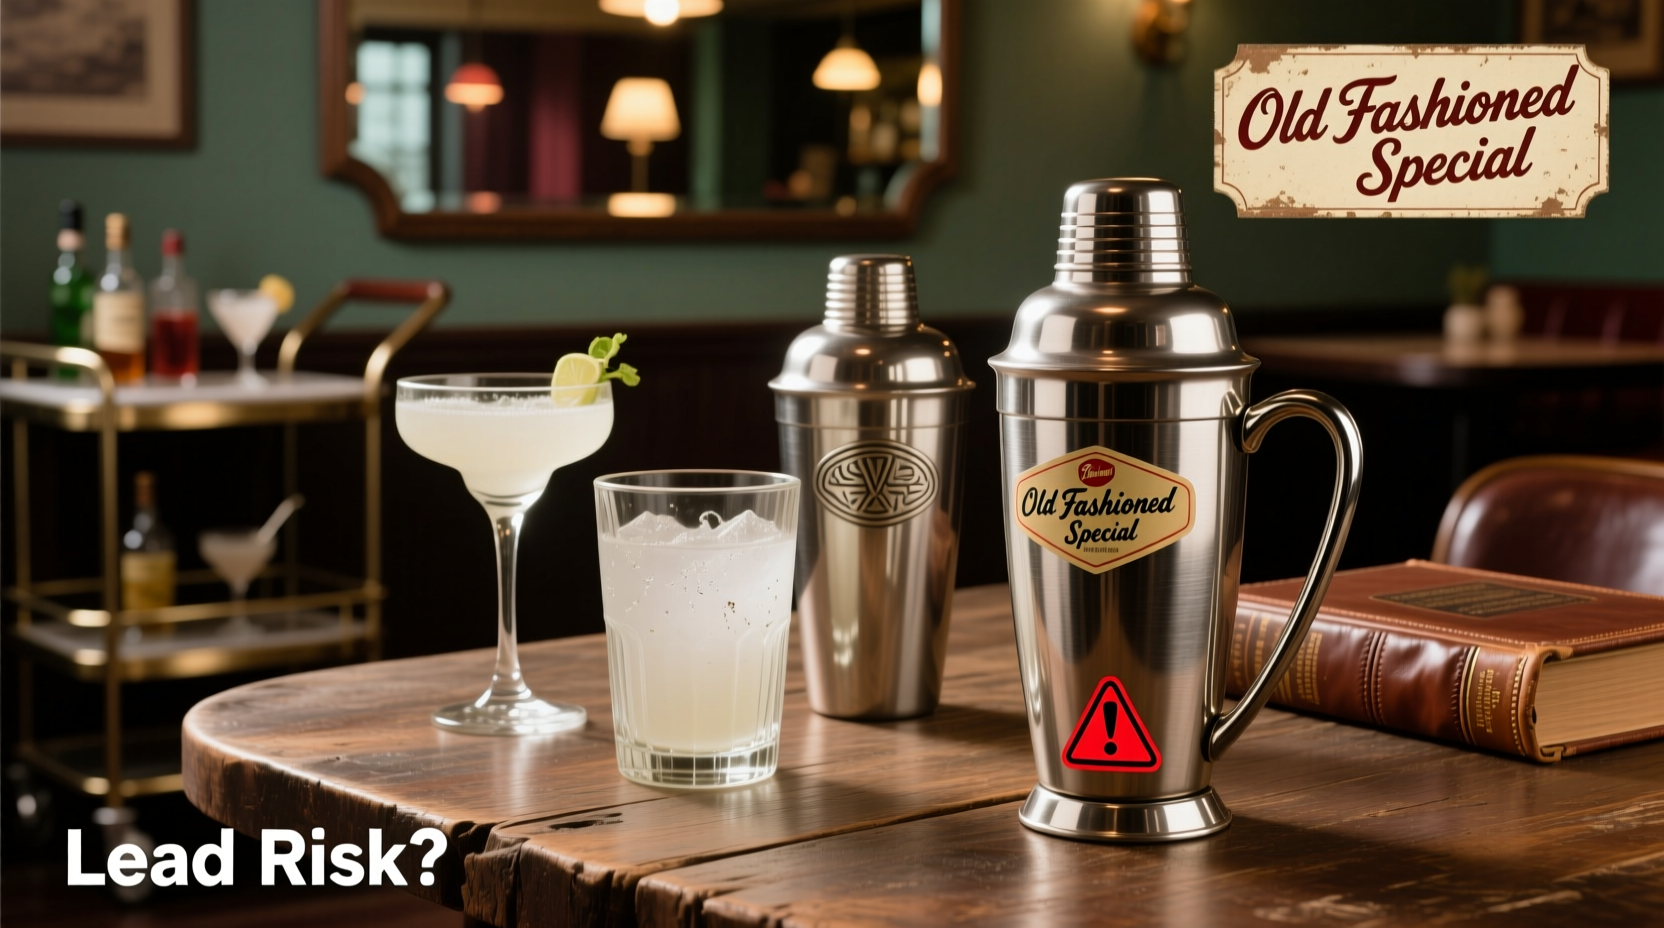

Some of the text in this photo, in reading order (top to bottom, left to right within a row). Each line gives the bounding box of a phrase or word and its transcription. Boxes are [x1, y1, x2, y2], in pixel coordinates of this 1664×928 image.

[1237, 64, 1580, 150] Old Fashioned
[1356, 126, 1537, 202] Special
[1022, 486, 1178, 520] Old Fashioned
[1064, 518, 1140, 549] Special
